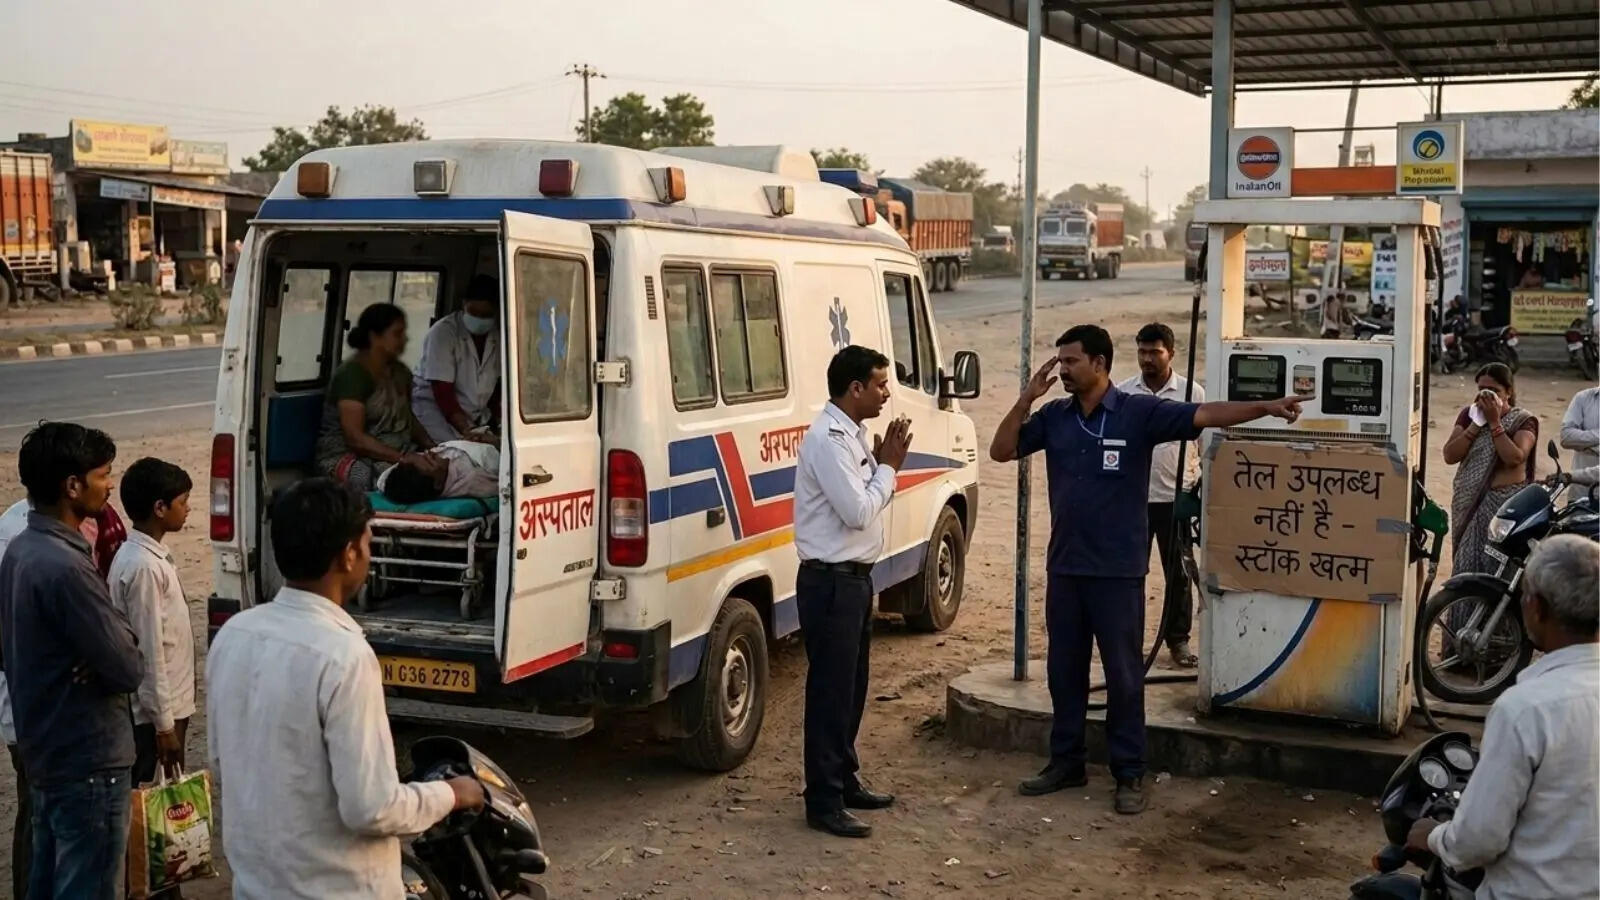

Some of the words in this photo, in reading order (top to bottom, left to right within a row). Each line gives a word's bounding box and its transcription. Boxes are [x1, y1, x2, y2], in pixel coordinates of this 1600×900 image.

[1233, 450, 1279, 490] तेल
[1287, 465, 1385, 500] उपलब्ध
[519, 488, 596, 541] अस्पताल
[1254, 500, 1304, 536] नहीं
[1312, 499, 1333, 539] है
[1235, 540, 1300, 576] स्टॉक
[1309, 552, 1375, 584] खत्म
